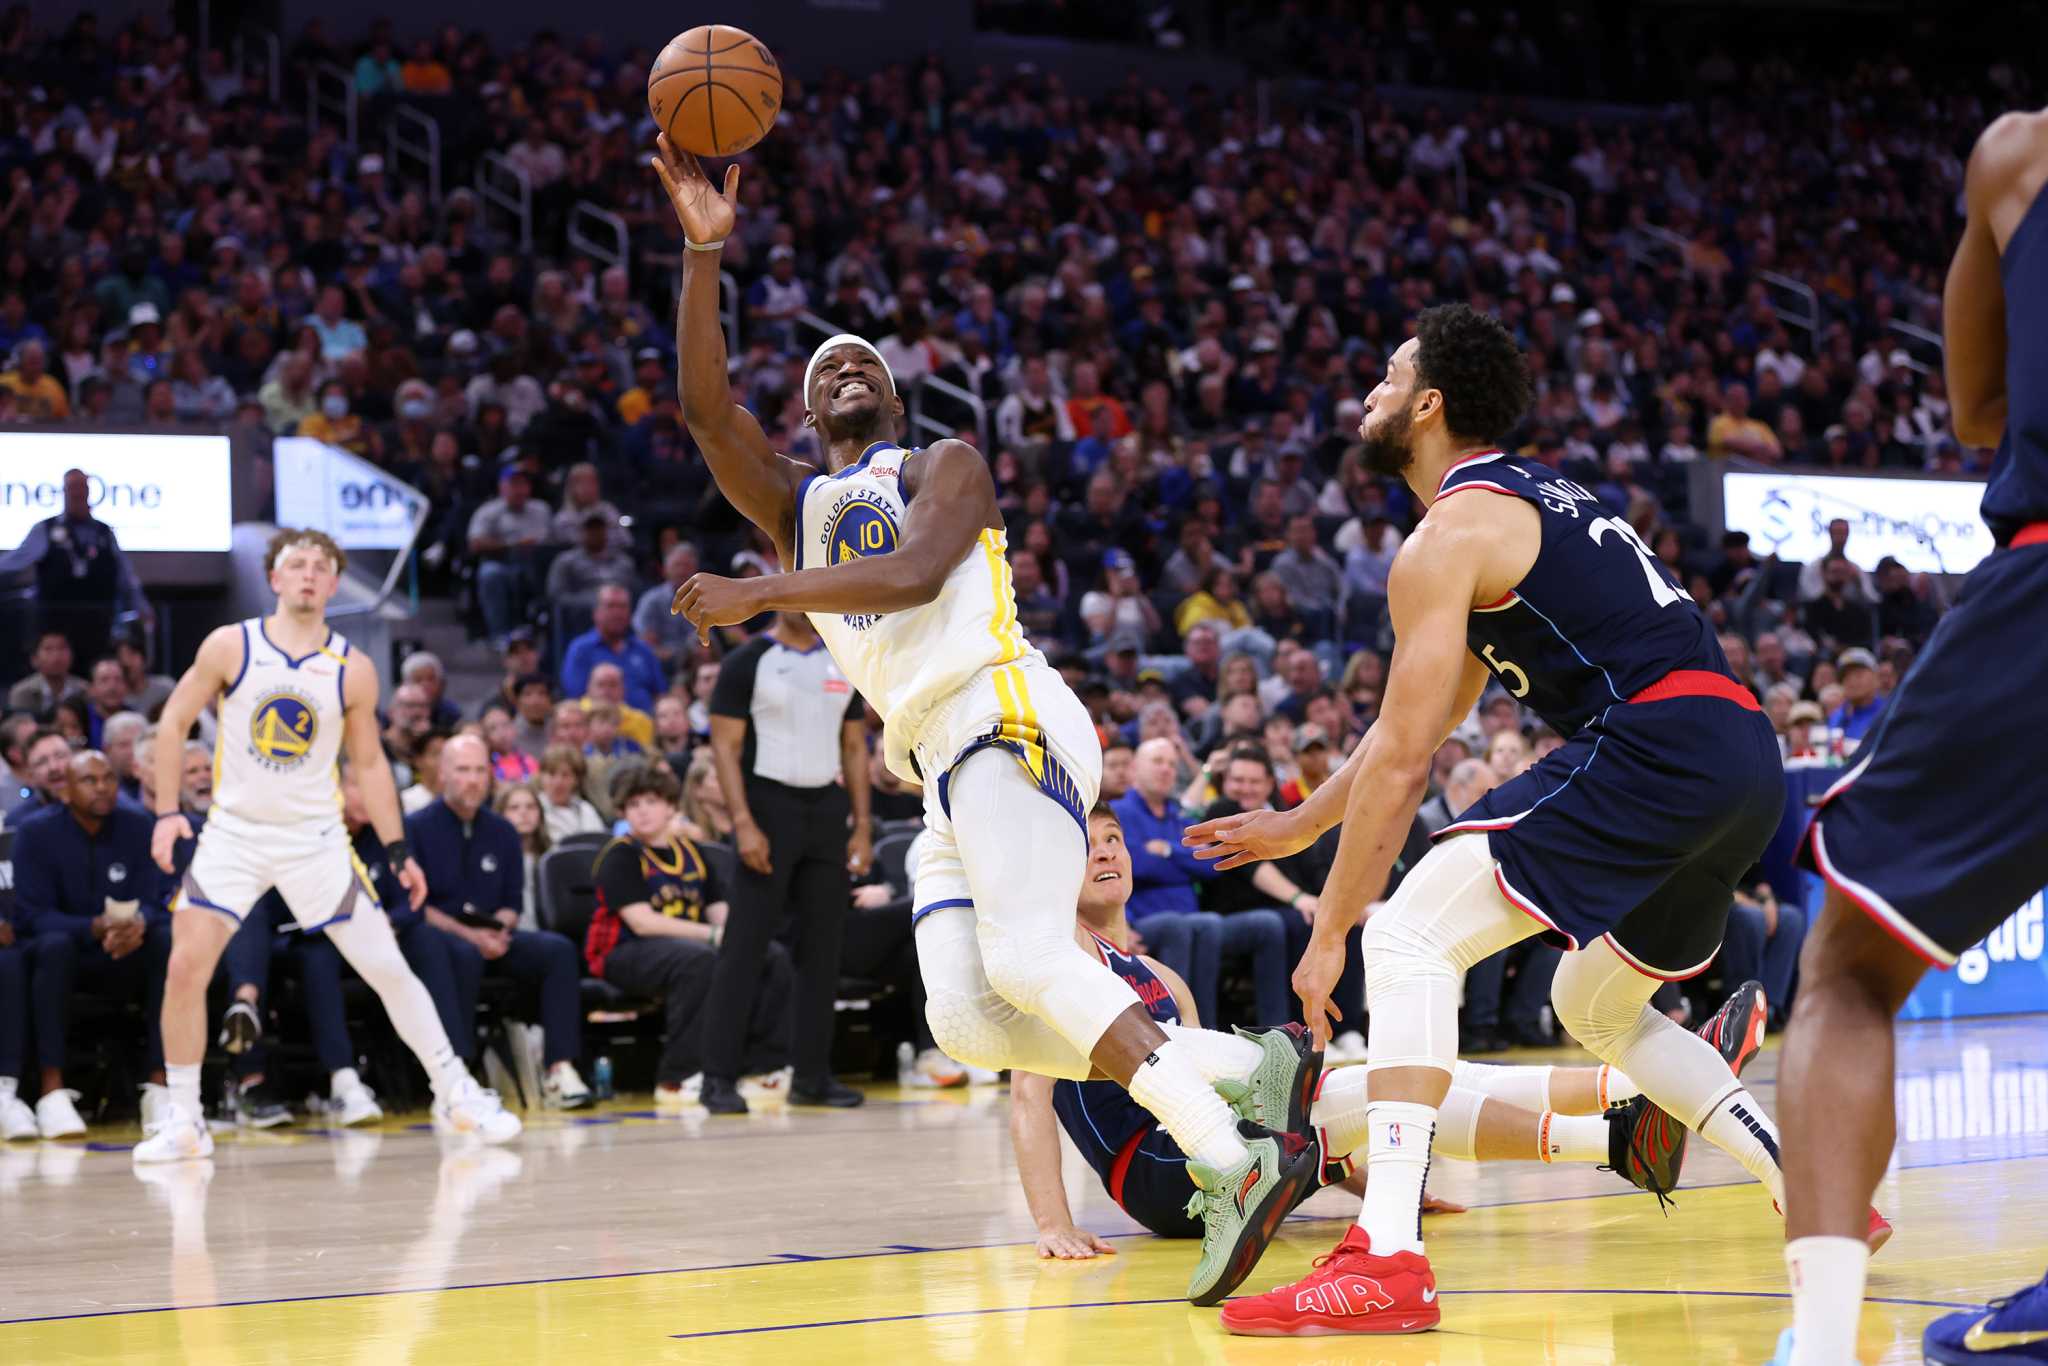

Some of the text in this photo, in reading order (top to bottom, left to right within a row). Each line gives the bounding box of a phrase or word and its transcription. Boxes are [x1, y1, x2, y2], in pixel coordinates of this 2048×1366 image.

[820, 490, 853, 544] GOLDEN
[860, 519, 884, 551] 10
[1481, 644, 1530, 697] 5
[294, 710, 309, 733] 2
[1295, 1274, 1395, 1316] AIR
